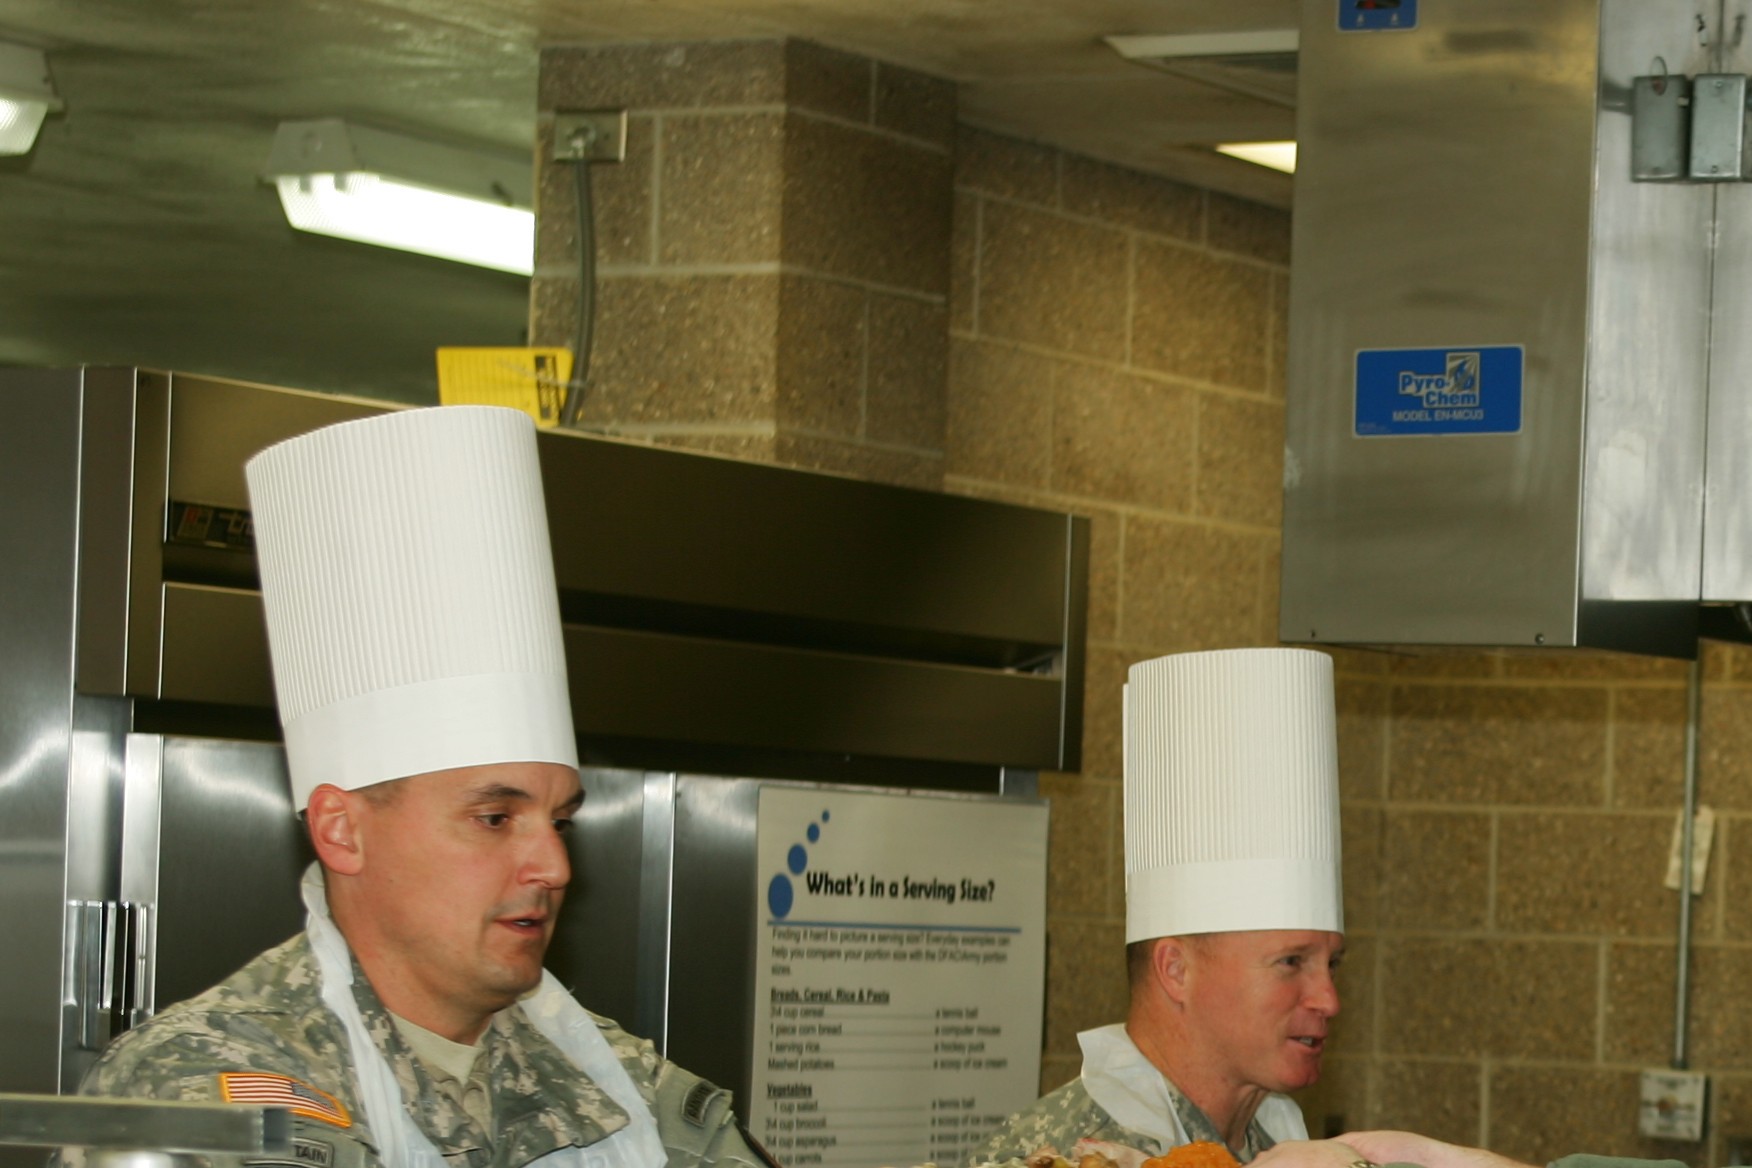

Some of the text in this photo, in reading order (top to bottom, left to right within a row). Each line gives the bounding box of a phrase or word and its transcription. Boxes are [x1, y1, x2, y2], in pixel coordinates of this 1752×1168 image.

[1426, 390, 1477, 406] Chem
[1392, 411, 1432, 422] MODEL
[806, 871, 996, 904] What's in a Serving Size?
[836, 987, 856, 1003] Rice
[767, 1083, 812, 1099] Vegetables
